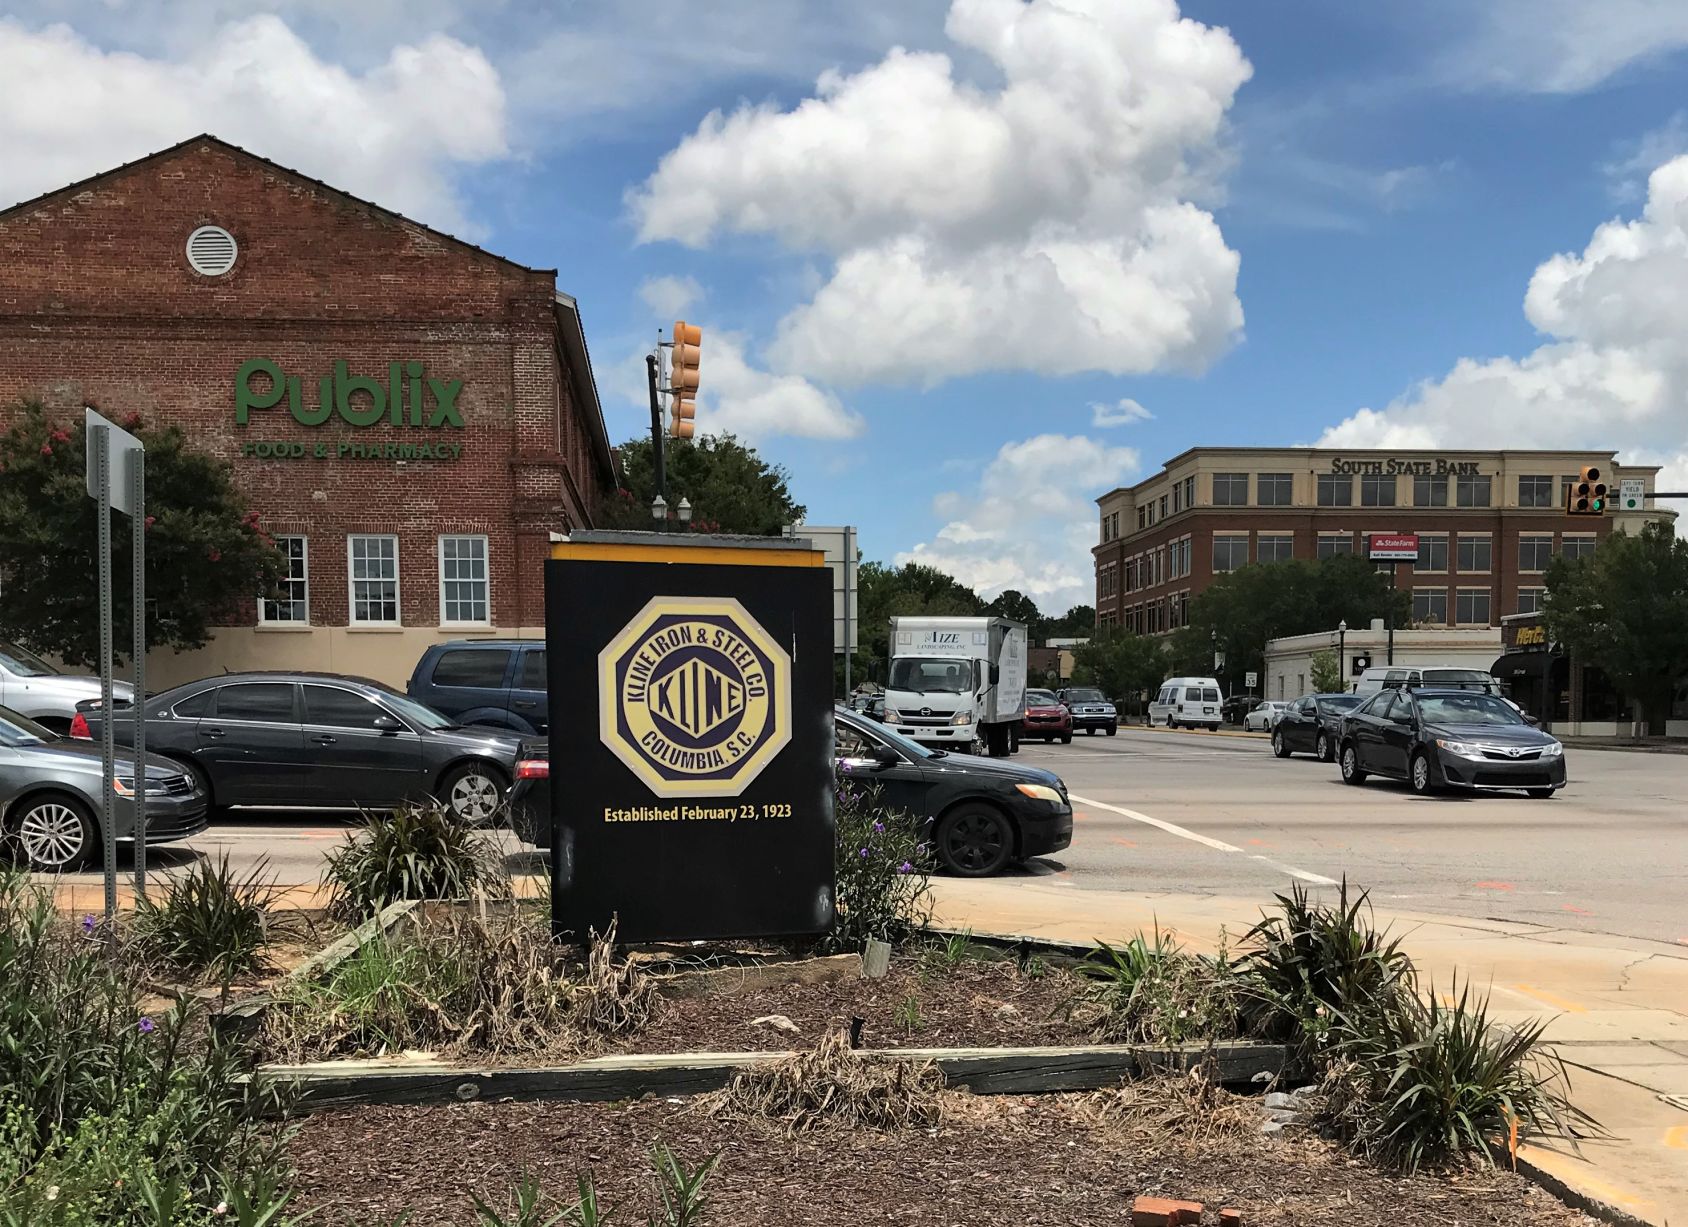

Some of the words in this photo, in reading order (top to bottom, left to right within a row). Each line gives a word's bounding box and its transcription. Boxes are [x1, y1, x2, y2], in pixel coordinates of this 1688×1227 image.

[235, 357, 465, 427] Publix
[243, 443, 305, 458] FOOD
[313, 443, 328, 458] &
[337, 442, 462, 459] PHARMACY
[1331, 457, 1383, 474] SOUTH
[1386, 457, 1431, 475] STATE
[1435, 458, 1480, 475] BANK
[627, 651, 657, 703] KLINE
[648, 625, 693, 658] IRON
[696, 628, 709, 643] &
[712, 629, 756, 673] STEEL
[657, 661, 742, 735] KLINE
[726, 731, 757, 758] S.C.
[604, 805, 679, 822] Established
[681, 804, 738, 823] February
[740, 804, 760, 820] 23,
[762, 803, 792, 818] 1923
